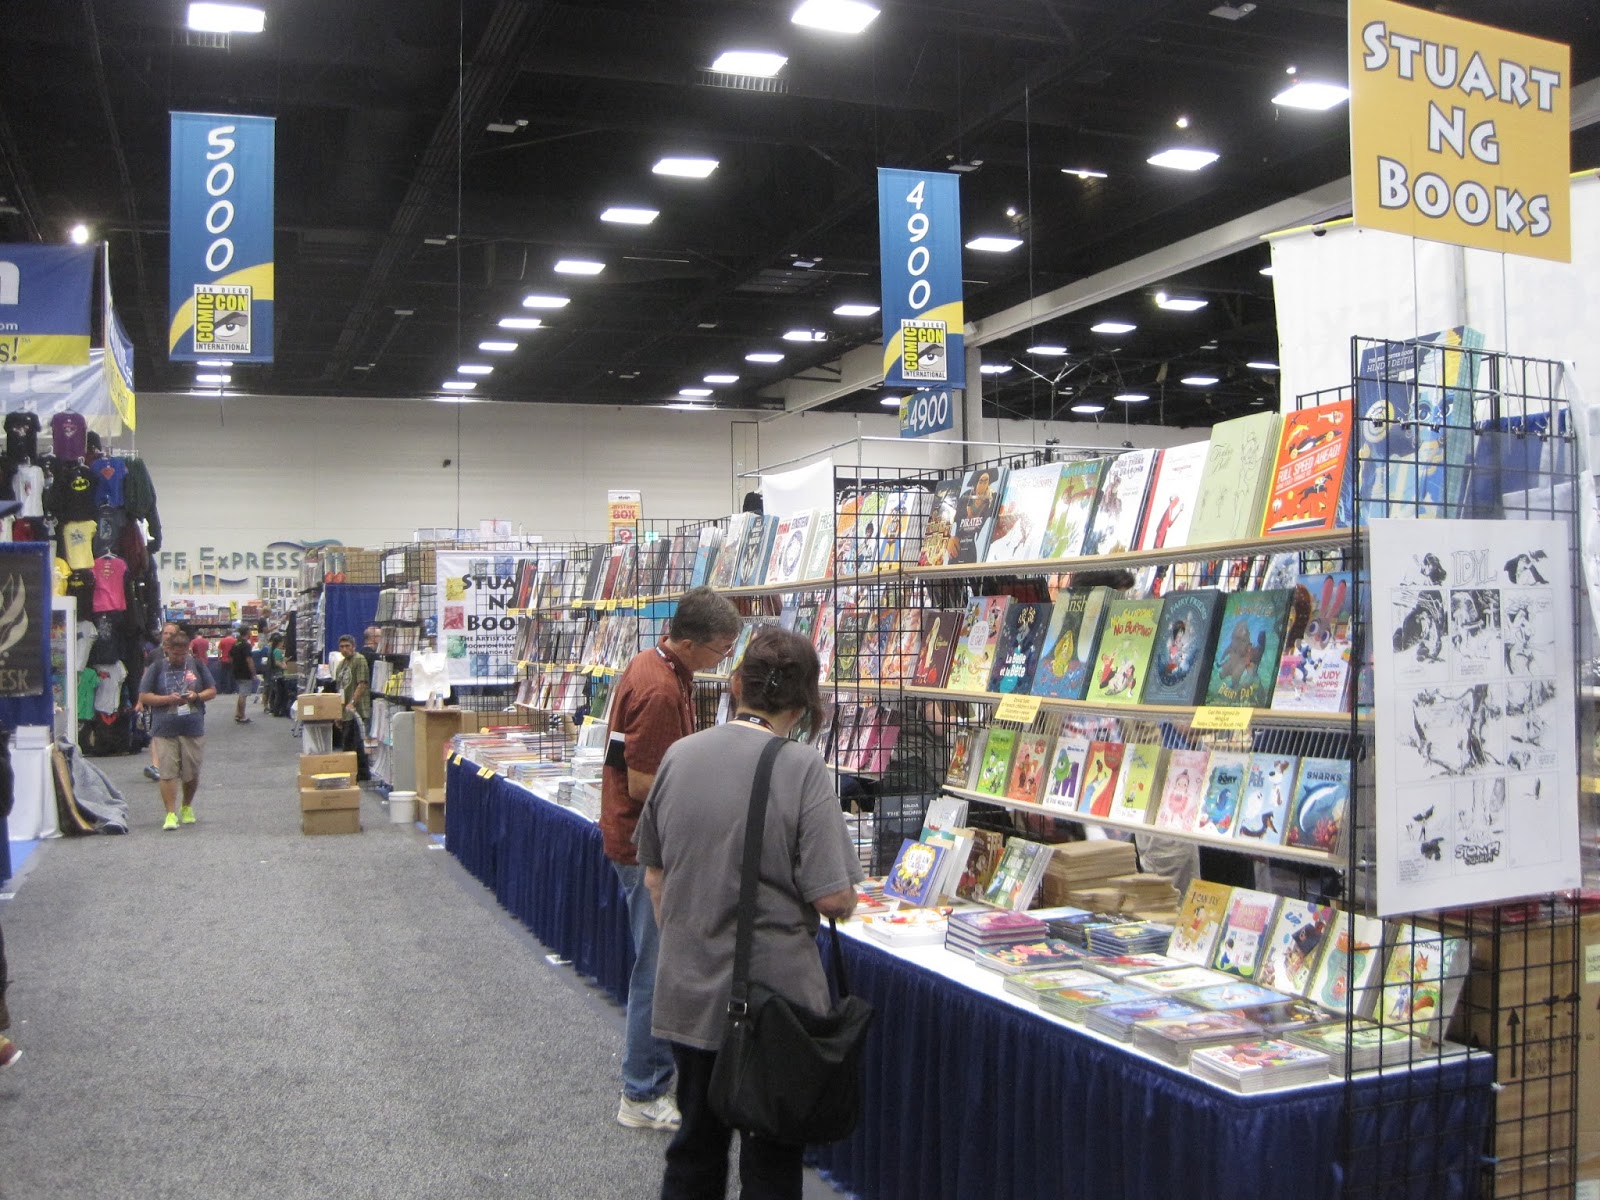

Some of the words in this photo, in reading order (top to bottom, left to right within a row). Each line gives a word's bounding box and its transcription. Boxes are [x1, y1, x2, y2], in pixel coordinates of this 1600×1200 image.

[1362, 20, 1560, 112] STUART
[1428, 100, 1500, 164] NG
[205, 125, 236, 272] 5000
[1377, 155, 1552, 237] BOOKS
[906, 180, 931, 310] 4900
[197, 293, 215, 342] COMIC
[215, 294, 249, 312] CON
[196, 343, 249, 351] INTERNATIONAL
[903, 327, 918, 370] COMIC
[918, 328, 944, 343] CON
[904, 370, 946, 379] INTERNATIONAL
[909, 391, 948, 432] 4900
[1294, 455, 1314, 476] SPEED
[1314, 442, 1342, 466] AHEAD!
[960, 516, 983, 528] PIRATES
[160, 551, 187, 570] FE
[1451, 549, 1498, 588] IDYL
[461, 573, 516, 590] STUA
[467, 614, 516, 631] BOO
[1318, 670, 1341, 680] JUDY
